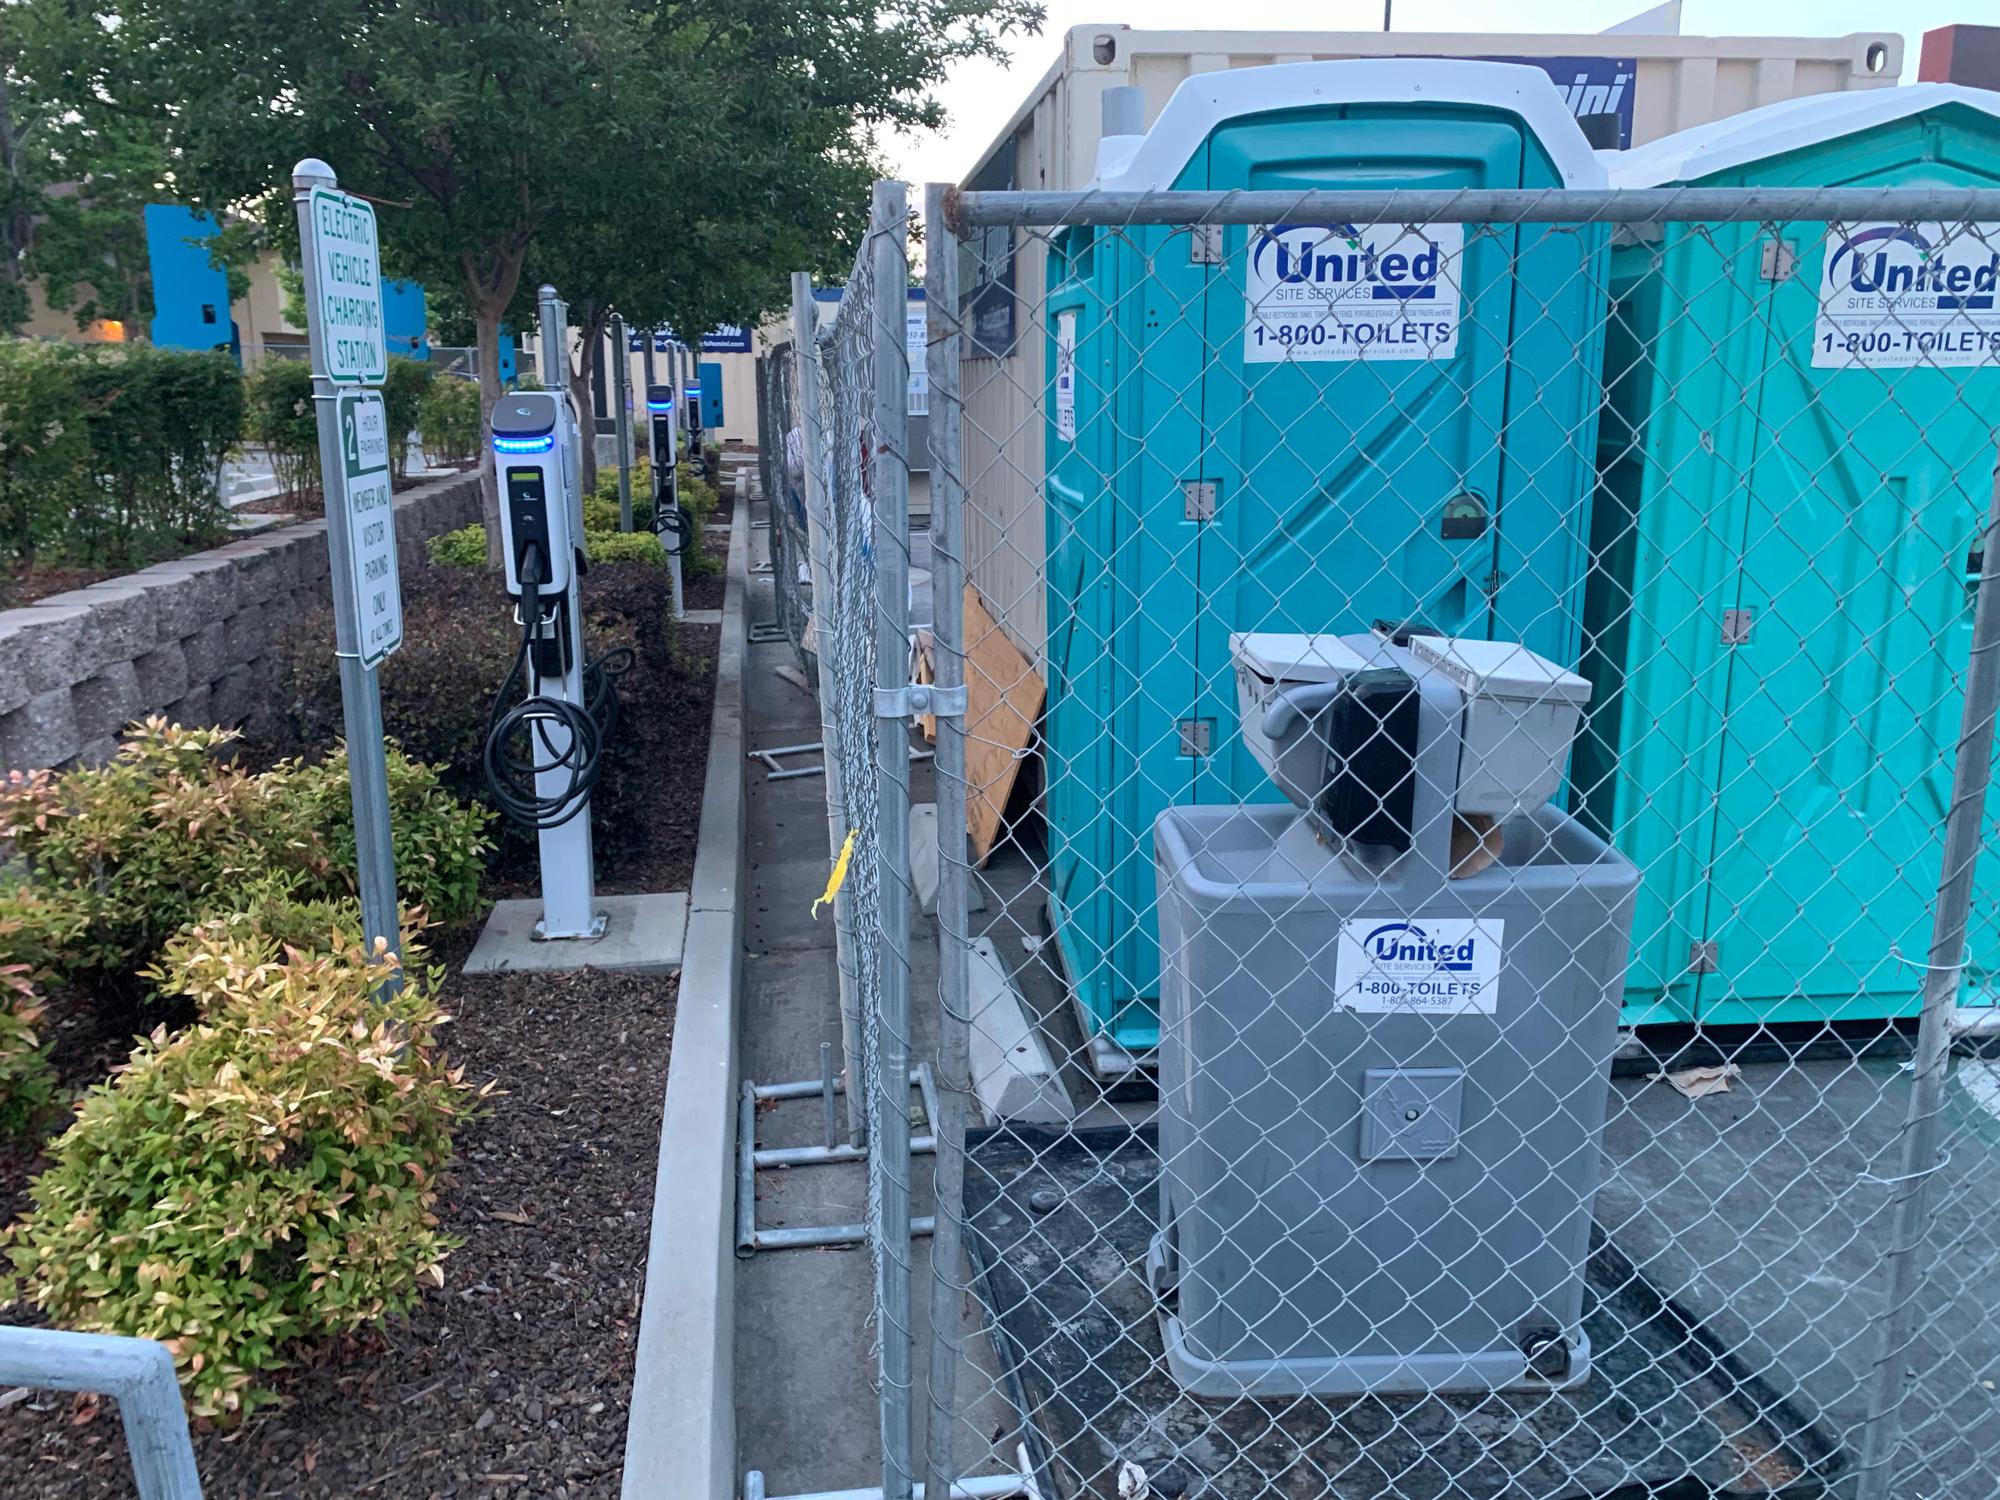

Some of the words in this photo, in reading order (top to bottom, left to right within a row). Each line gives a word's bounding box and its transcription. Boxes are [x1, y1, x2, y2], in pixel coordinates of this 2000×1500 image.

[321, 205, 370, 245] ELECTRIC
[327, 252, 371, 287] VEHICLE
[1276, 240, 1439, 284] United
[1850, 252, 2000, 293] United
[1275, 288, 1304, 300] SITE
[1307, 287, 1371, 300] SERVICES
[1847, 297, 1874, 309] SITE
[1878, 297, 1936, 309] SERVICES
[327, 295, 378, 329] CHARGING
[1253, 322, 1450, 346] 1-800-TOILETS
[1822, 331, 2000, 353] 1-800-TOILETS
[337, 340, 377, 369] STATION
[361, 414, 379, 432] HOUR
[345, 414, 356, 461] 2
[360, 437, 384, 456] PARKING
[352, 488, 375, 513] MEMBER
[376, 484, 388, 506] AND
[361, 520, 384, 547] VISITOR
[364, 554, 388, 584] PARKING
[372, 590, 386, 616] ONLY
[1376, 938, 1475, 962] United
[1393, 963, 1432, 971] SERVICES
[1355, 982, 1481, 995] 1-800-TOILETS
